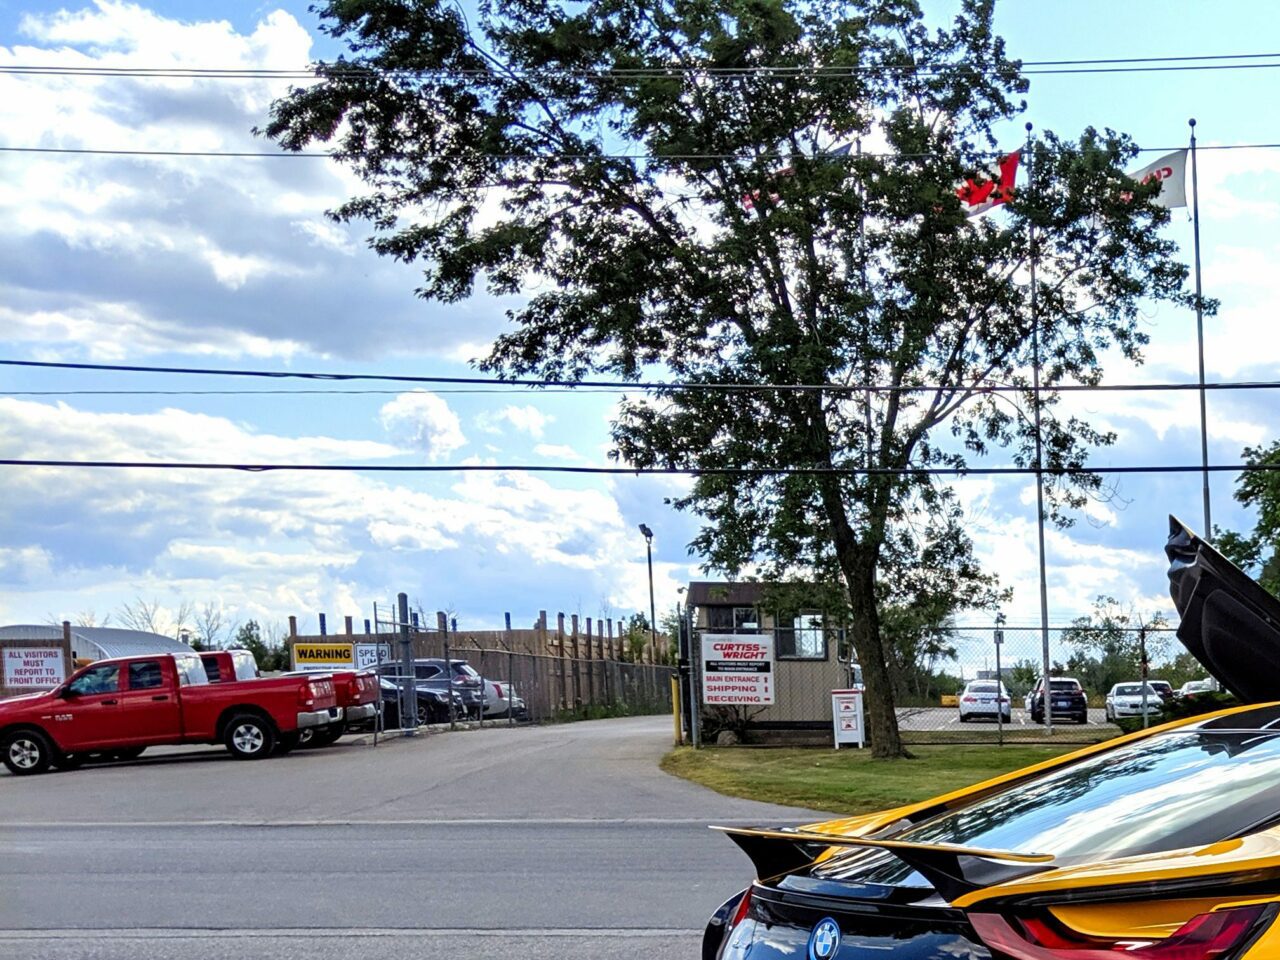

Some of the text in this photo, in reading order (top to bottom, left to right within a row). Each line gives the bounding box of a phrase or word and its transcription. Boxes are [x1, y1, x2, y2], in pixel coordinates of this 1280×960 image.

[297, 649, 351, 659] WARNING
[722, 651, 767, 659] WRIGHT
[14, 668, 55, 676] REPORT TO
